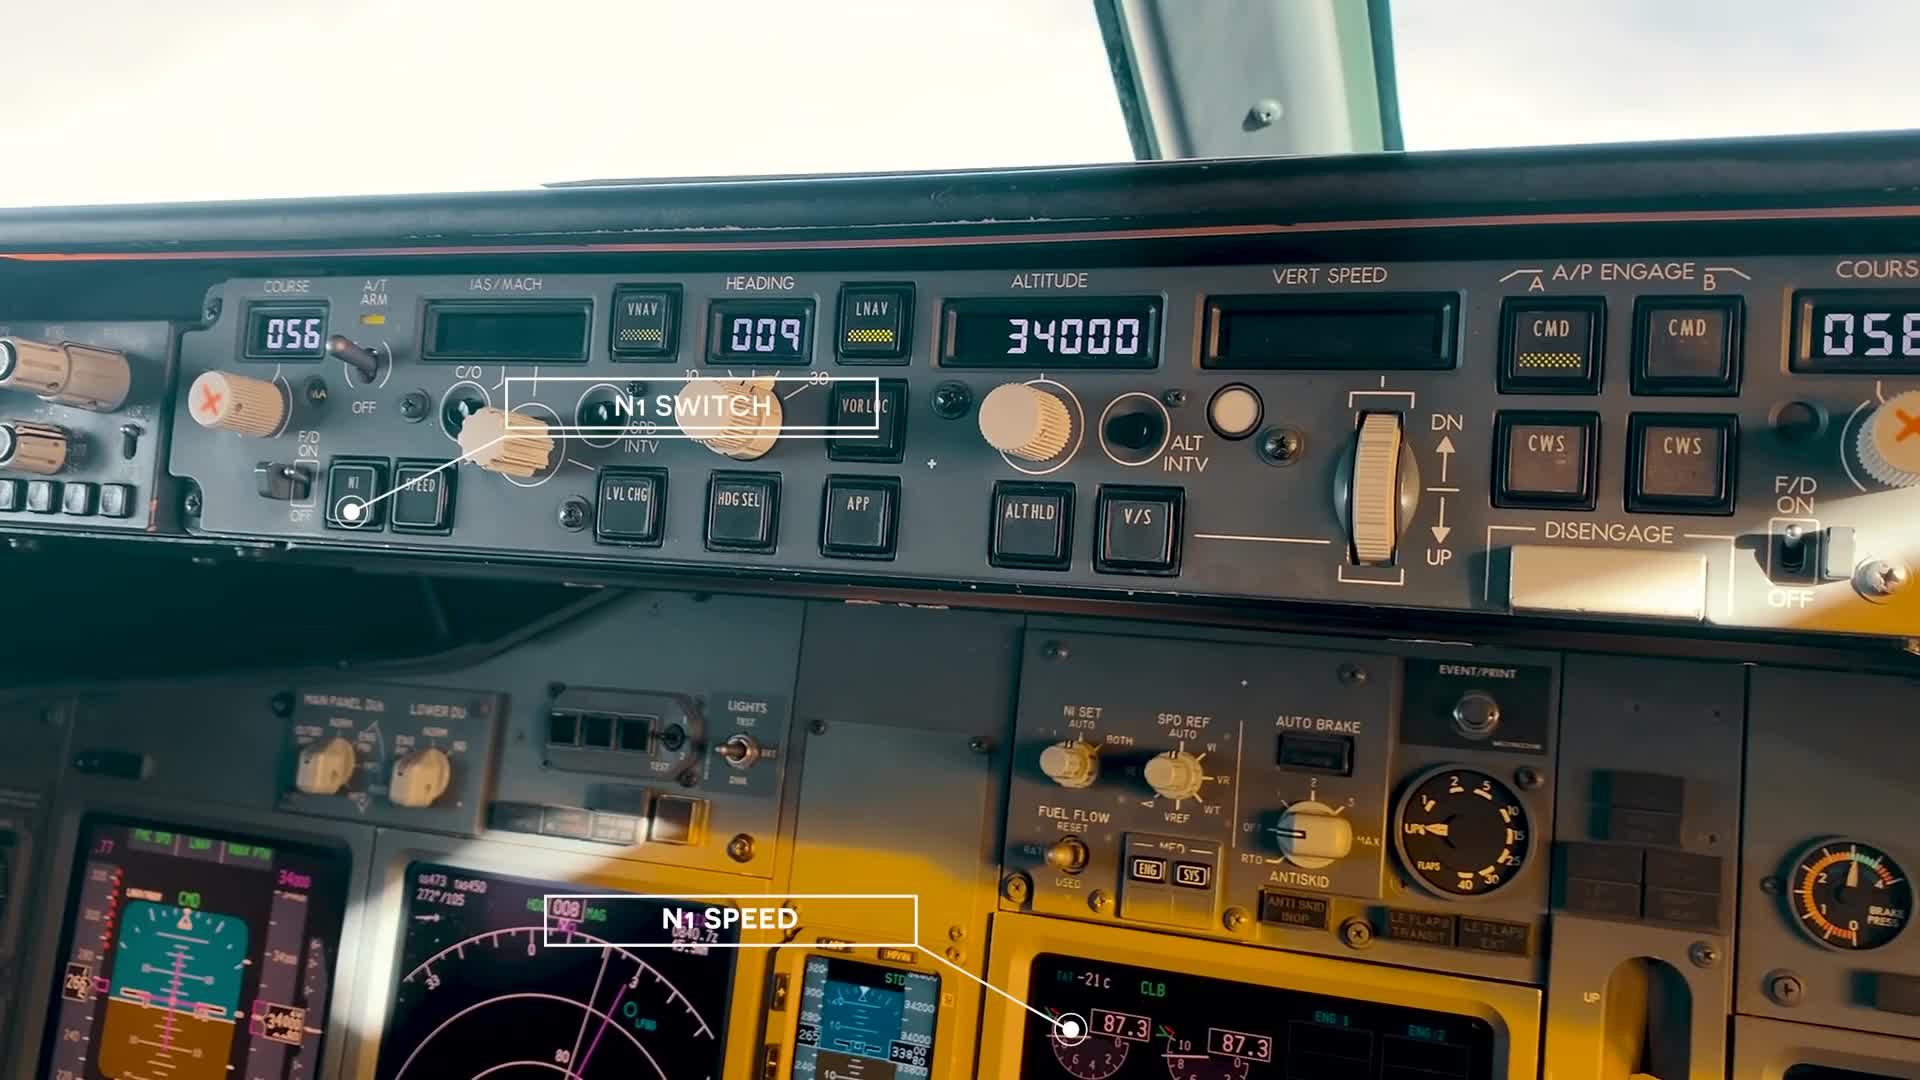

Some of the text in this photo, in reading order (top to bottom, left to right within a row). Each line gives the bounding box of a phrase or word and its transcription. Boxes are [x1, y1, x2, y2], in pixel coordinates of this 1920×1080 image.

[1272, 267, 1388, 285] VERT SPEED
[1552, 262, 1696, 280] A/P ENGAGE
[264, 280, 310, 293] COURSE
[363, 280, 389, 292] A/T
[469, 278, 542, 291] IAS/MACH
[726, 276, 795, 290] HEADING
[1011, 273, 1088, 288] ALTITUDE
[1528, 276, 1545, 292] A
[1703, 275, 1716, 291] B
[360, 294, 388, 305] ARM
[627, 302, 658, 316] VNAV
[856, 301, 888, 316] LNAV
[267, 319, 320, 349] 056
[731, 318, 800, 351] 009
[1533, 319, 1570, 337] CMD
[1668, 319, 1707, 337] CMD
[1007, 318, 1140, 354] 34000
[455, 365, 482, 379] C/O
[352, 401, 376, 415] OFF
[842, 399, 863, 413] VOR
[630, 420, 657, 435] SPD
[1431, 414, 1463, 431] DN
[298, 431, 320, 443] F/D
[1171, 435, 1204, 451] ALT
[1528, 434, 1565, 452] CWS
[298, 445, 319, 457] ON
[624, 439, 660, 454] INTV
[1664, 436, 1702, 455] CWS
[1163, 456, 1209, 472] INTV
[405, 478, 436, 493] SPEED
[1775, 476, 1817, 495] F/D
[607, 487, 648, 502] LVL CHG
[718, 492, 760, 508] HDG SEL
[847, 496, 870, 511] APP
[1777, 497, 1814, 514] ON
[1006, 503, 1055, 520] ALT HLD
[1123, 508, 1152, 525] V/S
[1545, 521, 1674, 544] DISENGAGE
[1426, 549, 1452, 566] UP
[1768, 591, 1814, 608] OFF
[1439, 664, 1518, 679] EVENT/PRINT
[410, 703, 449, 717] LOWER
[727, 700, 768, 714] LIGHTS
[1079, 706, 1102, 719] SET
[1068, 719, 1095, 730] AUTO
[1158, 713, 1211, 730] SPD REF
[1276, 716, 1361, 734] AUTO BRAKE
[1106, 735, 1134, 746] BOTH
[1168, 729, 1198, 740] AUTO
[650, 761, 670, 771] TEST
[1450, 776, 1459, 785] 2
[1483, 780, 1491, 791] 5
[1421, 794, 1427, 804] 1
[1038, 806, 1110, 824] FUEL FLOW
[1507, 805, 1520, 816] 10
[1164, 813, 1190, 824] VREF
[1057, 822, 1089, 833] RESET
[1514, 830, 1525, 840] 15
[1241, 853, 1263, 865] RTO
[1417, 860, 1441, 871] FLAPS
[1507, 855, 1521, 866] 25
[1139, 864, 1157, 876] ENG
[1184, 869, 1200, 882] SYS
[1055, 878, 1081, 889] USED
[1269, 871, 1329, 888] ANTISKID
[1457, 880, 1473, 890] 40
[1485, 874, 1500, 884] 30
[1818, 873, 1828, 883] 2
[1849, 920, 1858, 931] 0
[426, 974, 440, 990] 33
[629, 975, 640, 989] 3
[885, 973, 905, 986] STD
[1141, 980, 1166, 997] CLB
[1583, 992, 1601, 1003] UP
[904, 1000, 935, 1014] 34200
[1315, 1010, 1336, 1024] ENG
[1103, 1014, 1148, 1038] 87.3
[1408, 1025, 1431, 1039] ENG
[1178, 1039, 1191, 1052] 10
[1222, 1034, 1269, 1058] 87.3
[1072, 1054, 1079, 1064] 6
[1088, 1059, 1096, 1070] 4
[1105, 1053, 1112, 1064] 2
[1177, 1058, 1185, 1069] 8
[1233, 1057, 1241, 1068] 0
